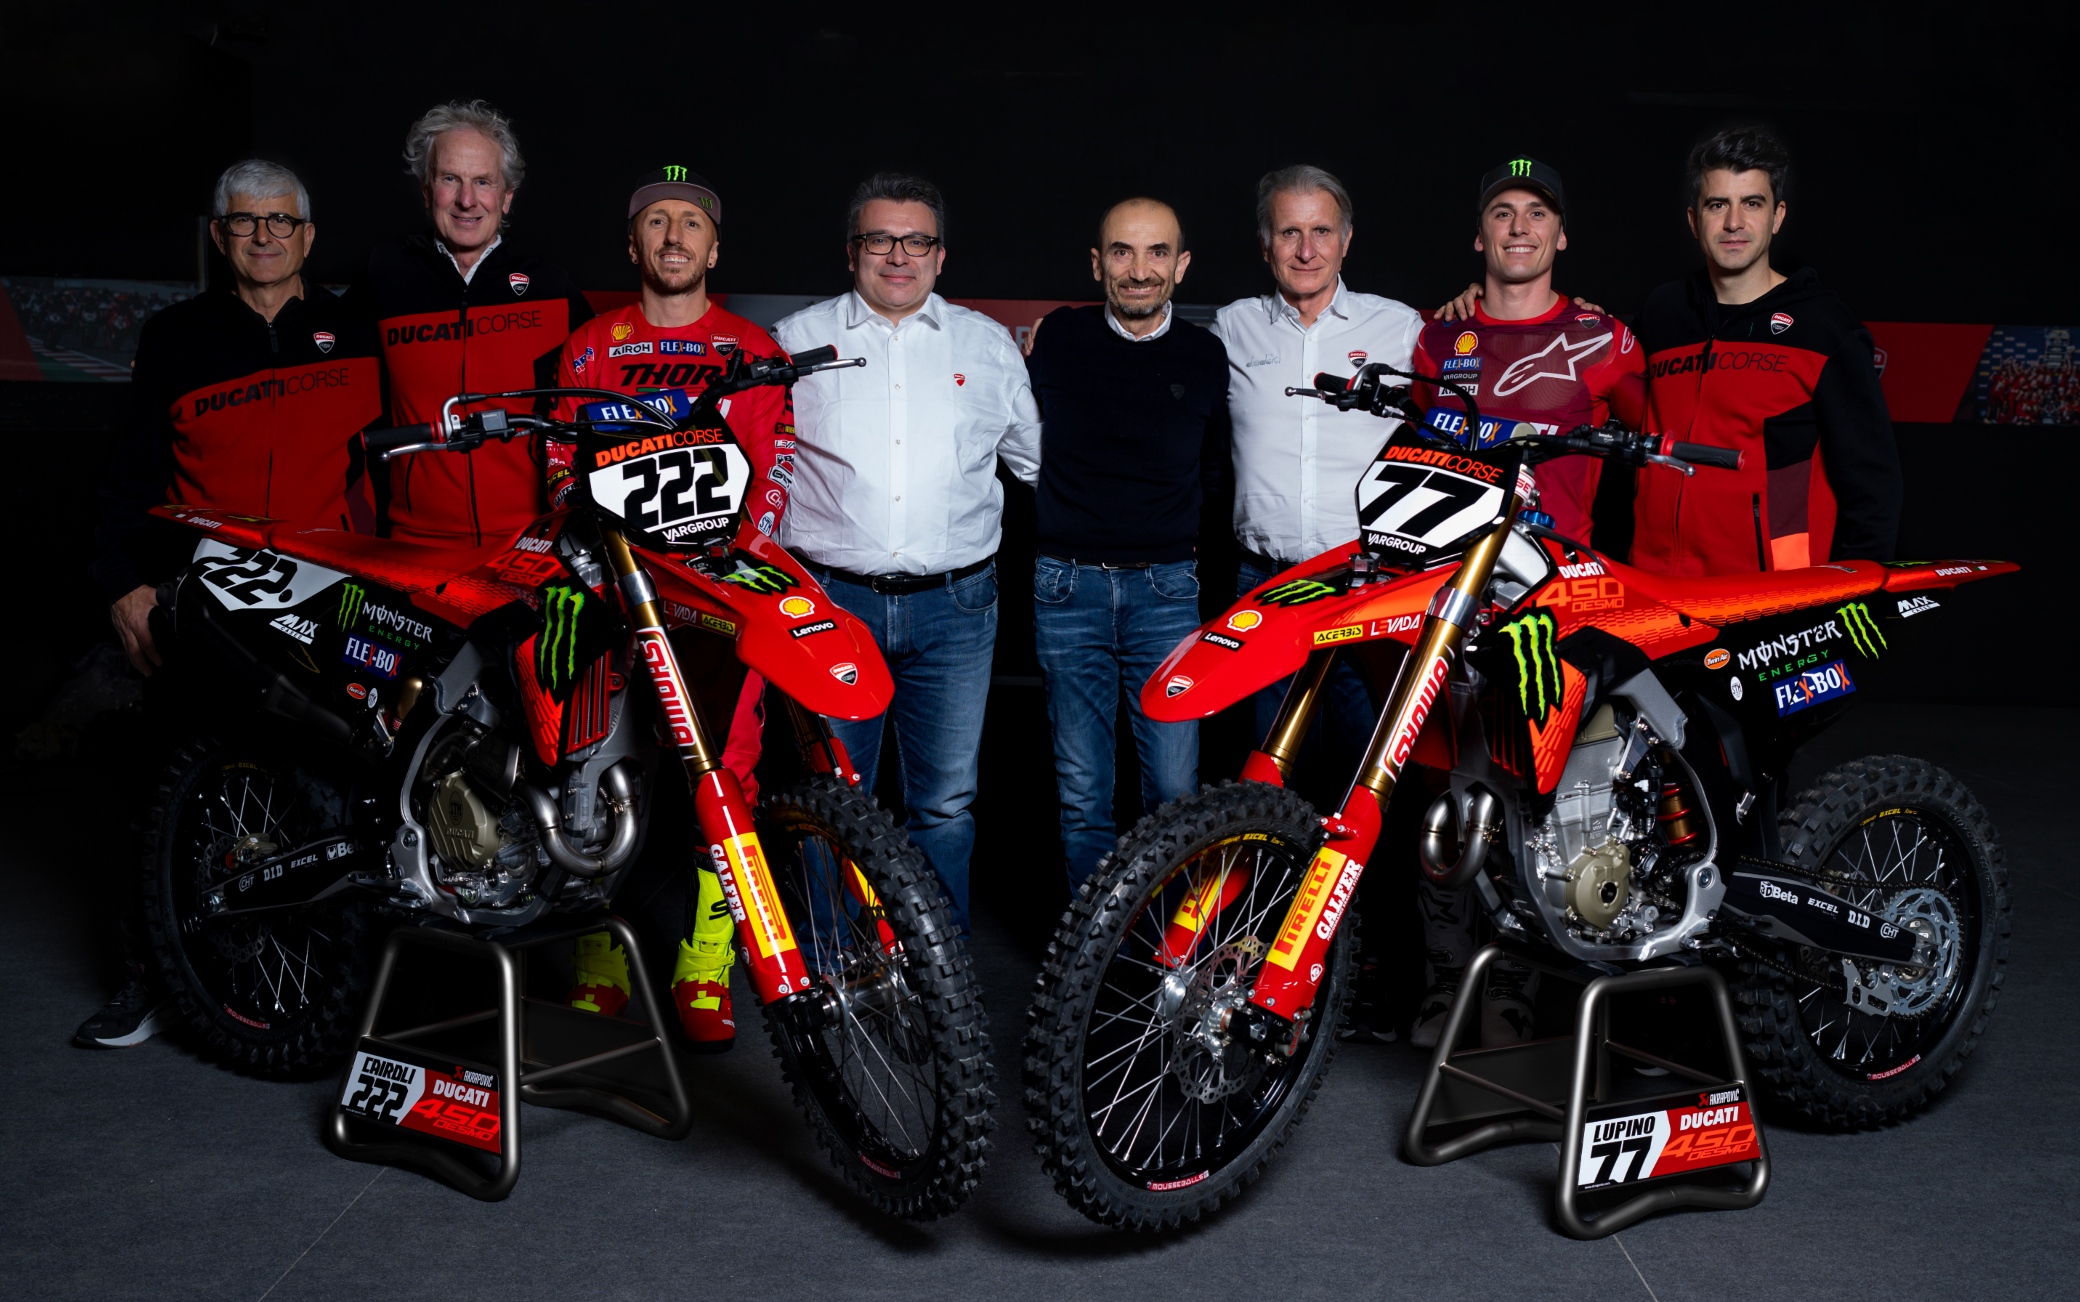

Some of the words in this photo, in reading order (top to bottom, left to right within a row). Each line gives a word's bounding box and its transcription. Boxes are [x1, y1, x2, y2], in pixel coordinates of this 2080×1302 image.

[612, 342, 651, 356] AIROH
[620, 363, 723, 387] THOR
[622, 447, 731, 526] 222
[1360, 464, 1491, 539] 77
[187, 516, 223, 529] DUCATI
[662, 517, 730, 542] VARGROUP
[515, 536, 552, 554] DUCATI
[1367, 532, 1427, 555] VARGROUP
[486, 551, 564, 576] 450
[1558, 561, 1605, 579] DUCATI
[1935, 566, 1973, 577] DUCATI
[499, 572, 545, 587] DESMO
[1536, 577, 1625, 608] 450
[1897, 595, 1935, 613] MAX
[1571, 598, 1625, 613] DESMO
[274, 613, 319, 638] MAX
[368, 624, 421, 650] ENERGY
[792, 621, 834, 638] Lenovo
[1370, 614, 1421, 637] LEVADA
[1205, 633, 1240, 649] Lenovo
[345, 636, 401, 678] FLEX-BOX
[1758, 649, 1829, 682] ENERGY
[640, 639, 697, 747] SHOWA
[1775, 663, 1850, 710] FLEX-BOX
[1392, 656, 1449, 768] SHOWA
[446, 828, 475, 839] DUCATI
[1242, 833, 1268, 842] EXCEL
[290, 854, 319, 868] EXCEL
[710, 843, 746, 924] GALFER
[735, 845, 787, 942] PIRELLI
[1773, 886, 1799, 905] Beta
[1274, 857, 1332, 956] PIRELLI
[1316, 859, 1361, 940] GALFER
[1807, 897, 1839, 914] EXCEL
[362, 1057, 416, 1084] CAIROLI
[1872, 1058, 1916, 1080] MOUSSEBALLS
[348, 1074, 408, 1125] 222
[432, 1080, 490, 1108] DUCATI
[411, 1098, 501, 1133] 450
[1680, 1106, 1740, 1131] DUCATI
[433, 1119, 493, 1141] DESMO
[1593, 1116, 1656, 1142] LUPINO
[1660, 1124, 1757, 1158] 450
[1590, 1136, 1653, 1184] 77
[1687, 1143, 1751, 1161] DESMO
[1152, 1174, 1203, 1190] MOUSSEBALLS
